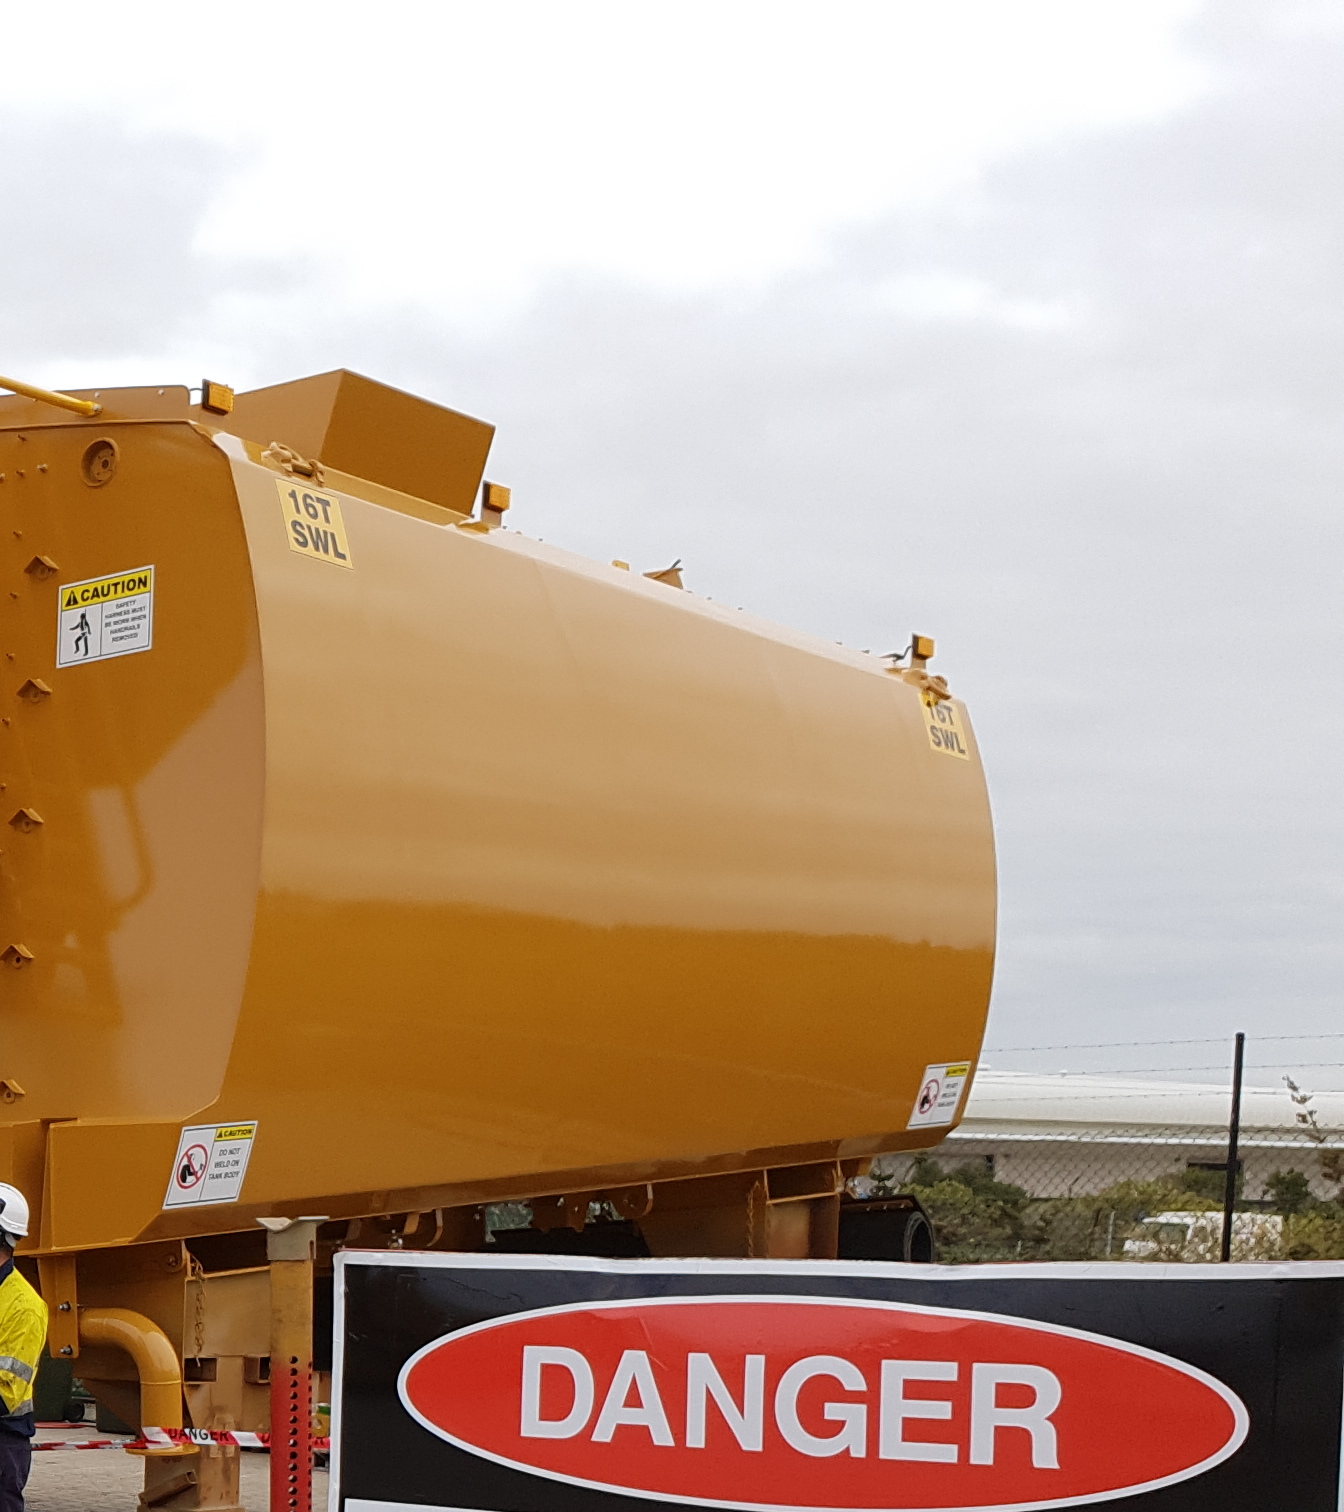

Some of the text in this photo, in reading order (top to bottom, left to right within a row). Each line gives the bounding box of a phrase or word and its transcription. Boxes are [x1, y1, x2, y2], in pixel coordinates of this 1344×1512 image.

[288, 489, 331, 525] 16T
[291, 519, 348, 561] SWL
[80, 575, 148, 602] CAUTION
[930, 724, 966, 755] SWL
[223, 1129, 253, 1138] CAUTION
[218, 1147, 241, 1156] DO NOT
[519, 1343, 1063, 1471] DANGER
[169, 1427, 230, 1442] DANGER
